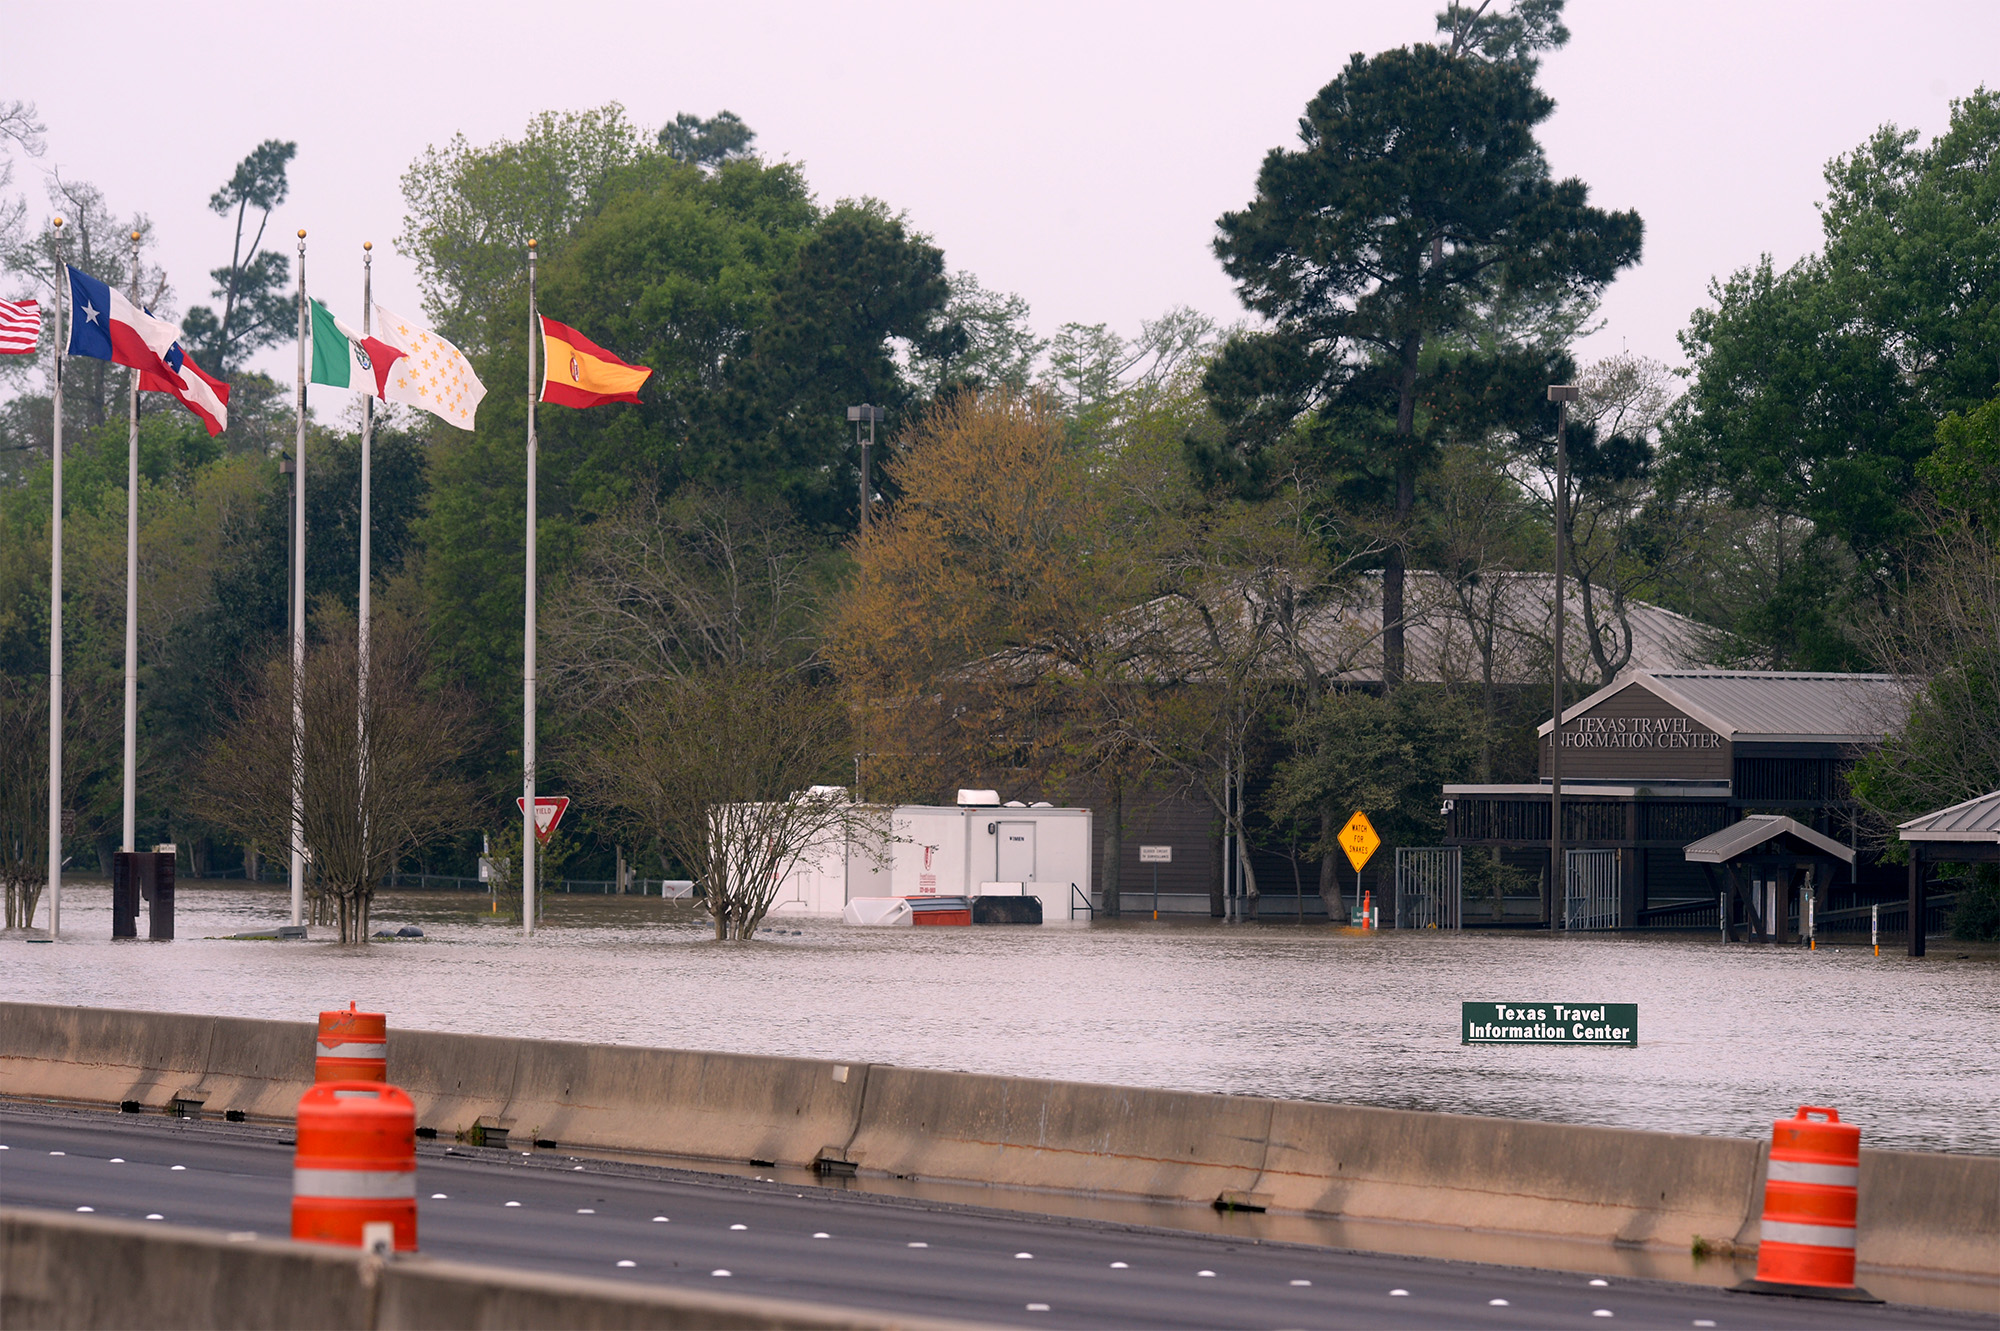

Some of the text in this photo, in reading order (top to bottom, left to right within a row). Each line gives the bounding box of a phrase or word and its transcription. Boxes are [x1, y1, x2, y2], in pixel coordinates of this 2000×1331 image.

[1577, 717, 1692, 733] TEXAS TRAVEL
[1658, 732, 1720, 748] CENTER
[536, 807, 552, 815] YIELD
[1352, 824, 1368, 832] WATCH
[1354, 834, 1364, 843] FOR
[1349, 845, 1369, 855] SNAKES
[1495, 1004, 1605, 1022] Texas Travel
[1469, 1022, 1630, 1040] Information Center
